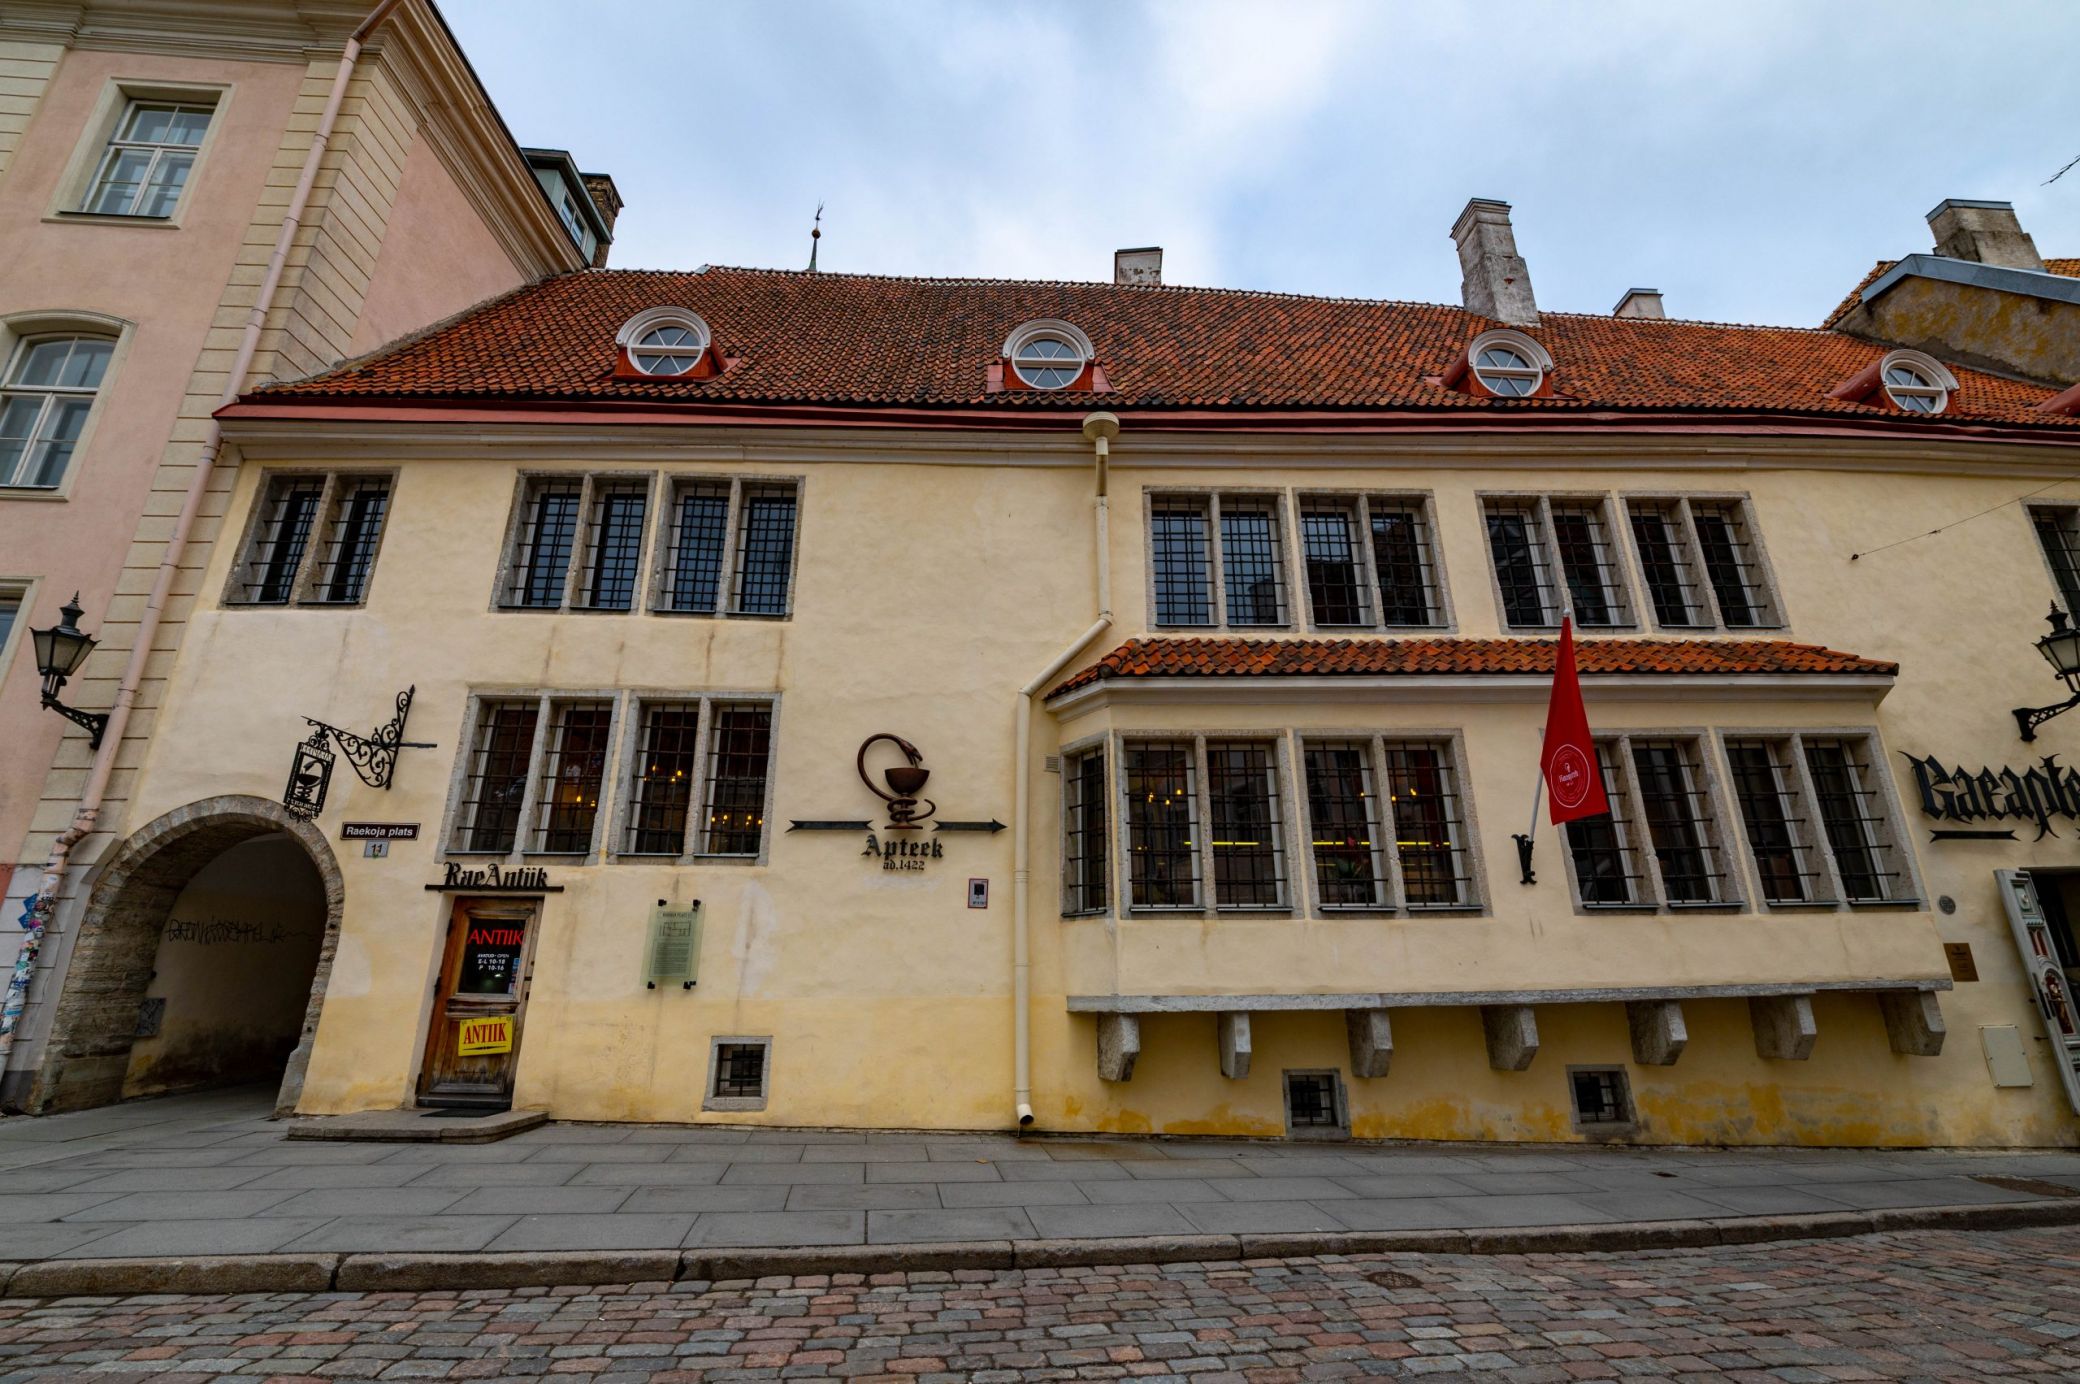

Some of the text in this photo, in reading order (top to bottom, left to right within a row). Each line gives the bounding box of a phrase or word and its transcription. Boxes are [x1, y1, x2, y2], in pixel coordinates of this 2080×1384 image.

[346, 826, 413, 838] Raekoja plats
[371, 844, 383, 854] 11
[861, 834, 944, 860] Apteek
[467, 928, 525, 945] ANTIIK
[463, 1022, 507, 1045] ANTIIK
